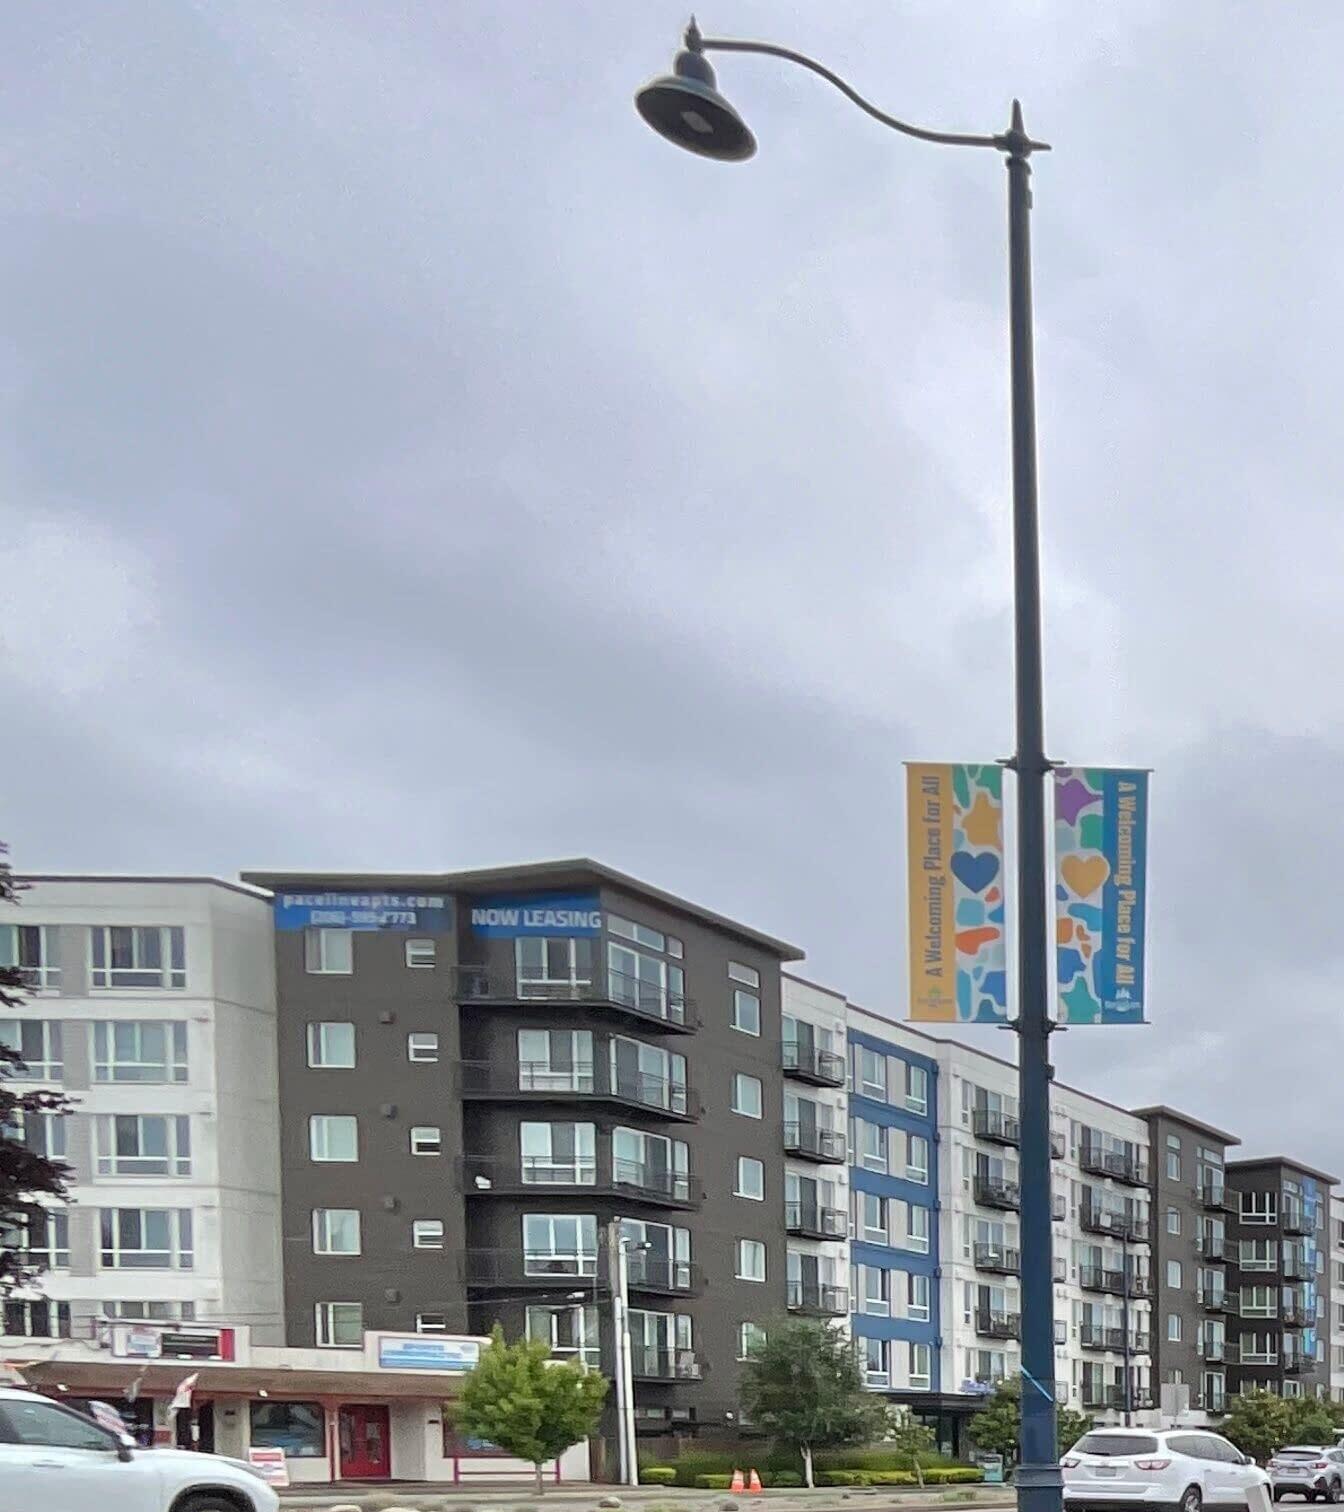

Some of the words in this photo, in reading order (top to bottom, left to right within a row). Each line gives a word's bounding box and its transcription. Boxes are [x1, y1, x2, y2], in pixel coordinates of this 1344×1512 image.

[921, 775, 940, 796] All
[1117, 781, 1137, 793] A
[922, 799, 942, 825] for
[923, 826, 942, 873] Place
[1114, 795, 1137, 886] Welcoming
[471, 908, 518, 926] NOW
[523, 909, 601, 928] LEASING
[924, 875, 946, 964] Welcoming
[1117, 890, 1137, 936] Place
[1116, 937, 1136, 963] for
[926, 965, 943, 978] A
[1115, 964, 1136, 985] All
